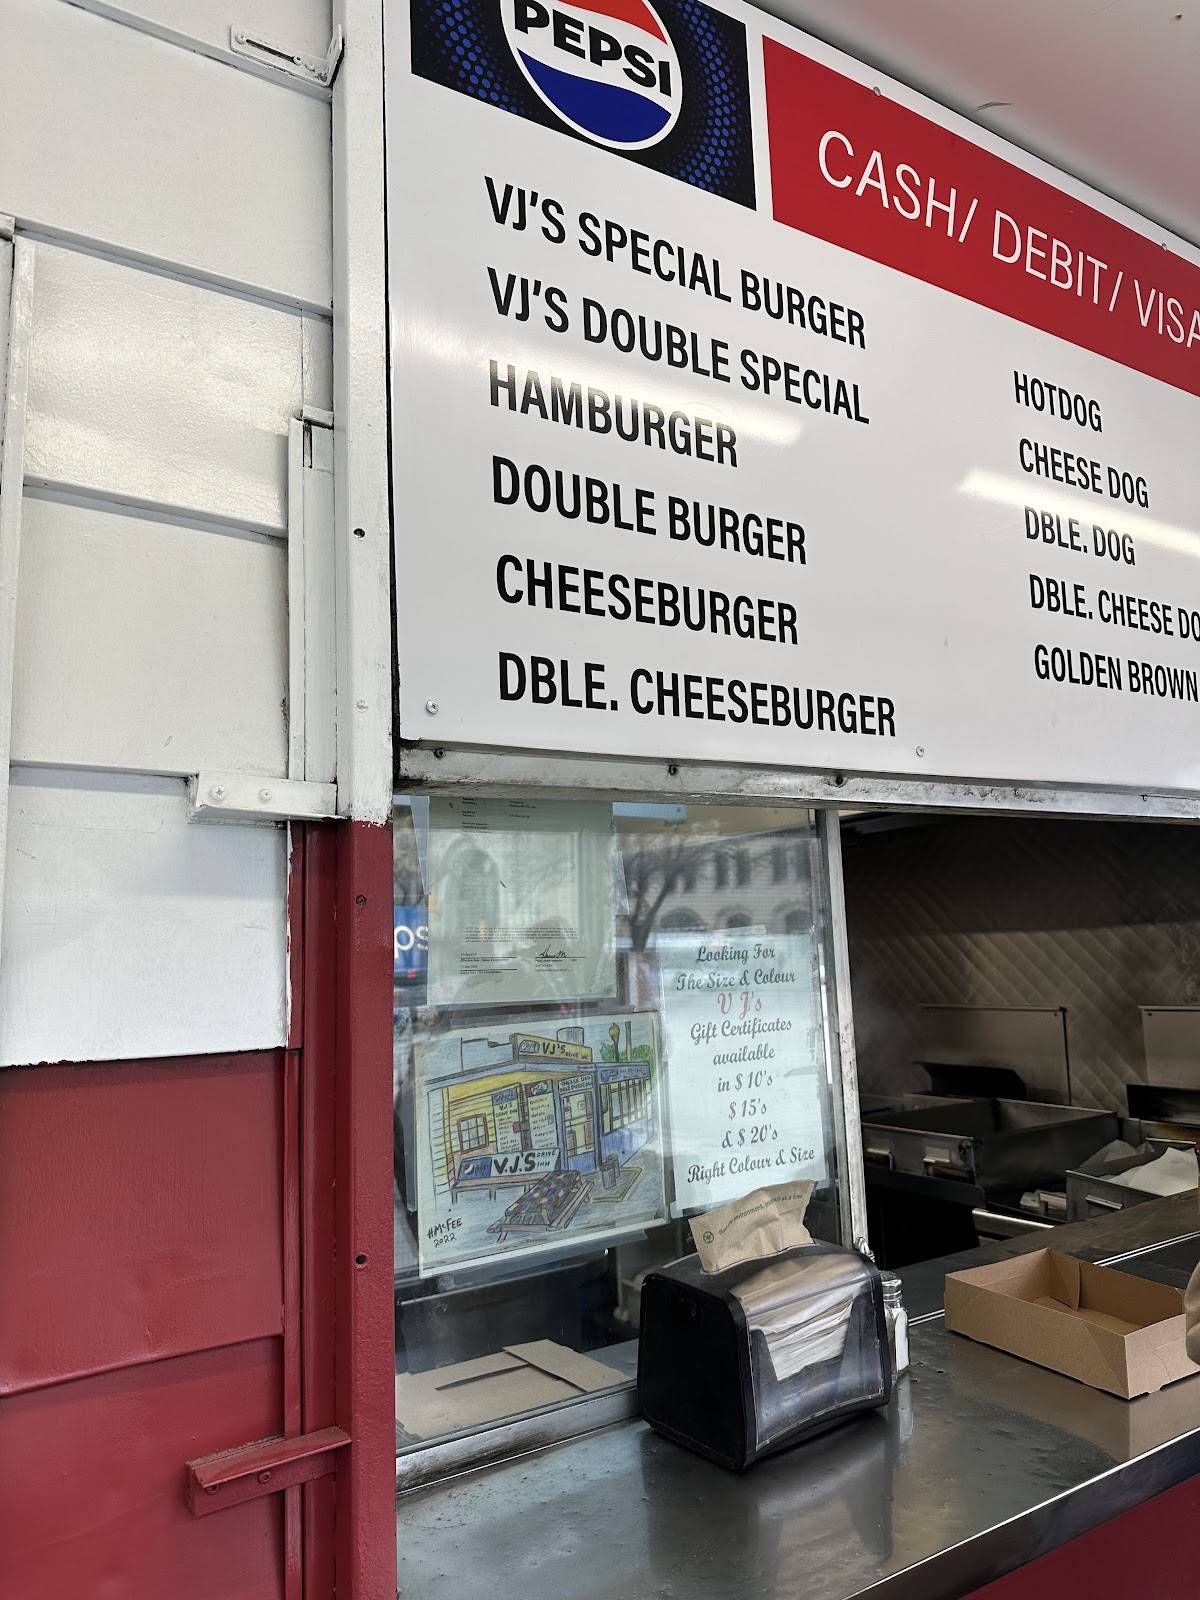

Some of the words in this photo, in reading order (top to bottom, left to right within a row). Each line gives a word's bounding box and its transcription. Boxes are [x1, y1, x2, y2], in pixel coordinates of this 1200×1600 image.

[513, 2, 673, 97] PEPSI
[484, 175, 566, 244] VJ'S
[578, 212, 732, 303] SPECIAL
[740, 268, 866, 349] BURGER
[818, 130, 979, 243] CASH/
[992, 209, 1124, 312] DEBIT/
[1134, 279, 1200, 348] VISA
[487, 266, 570, 334] VJ'S
[582, 297, 731, 383] DOUBLE
[740, 349, 870, 425] SPECIAL
[489, 359, 738, 468] HAMBURGER
[1013, 370, 1103, 433] HOTDOG
[1019, 438, 1103, 494] CHEESE
[1107, 466, 1149, 508] DOG
[492, 455, 657, 535] DOUBLE
[668, 495, 807, 565] BURGER
[1025, 505, 1088, 554] DBLE.
[1092, 524, 1136, 566] DOG
[496, 554, 798, 645] CHEESEBURGER
[1029, 573, 1093, 620] DBLE.
[1098, 589, 1174, 636] CHEESE
[498, 651, 618, 711] DBLE.
[630, 668, 896, 736] CHEESEBURGER
[1034, 644, 1123, 691] GOLDEN
[1128, 660, 1198, 702] BROWN
[676, 973, 702, 991] The
[707, 971, 735, 988] Size
[739, 970, 749, 986] &
[754, 968, 796, 985] Colour
[696, 945, 750, 966] Looking
[753, 943, 775, 960] For
[690, 1022, 717, 1046] Gift
[721, 1017, 792, 1040] Certificates
[713, 1043, 776, 1066] available
[718, 1078, 730, 1092] in
[687, 1161, 725, 1185] Right
[729, 1155, 772, 1175] Colour
[775, 1149, 785, 1165] &
[790, 1147, 815, 1165] Size
[721, 1131, 733, 1149] &
[433, 1232, 457, 1249] 2022
